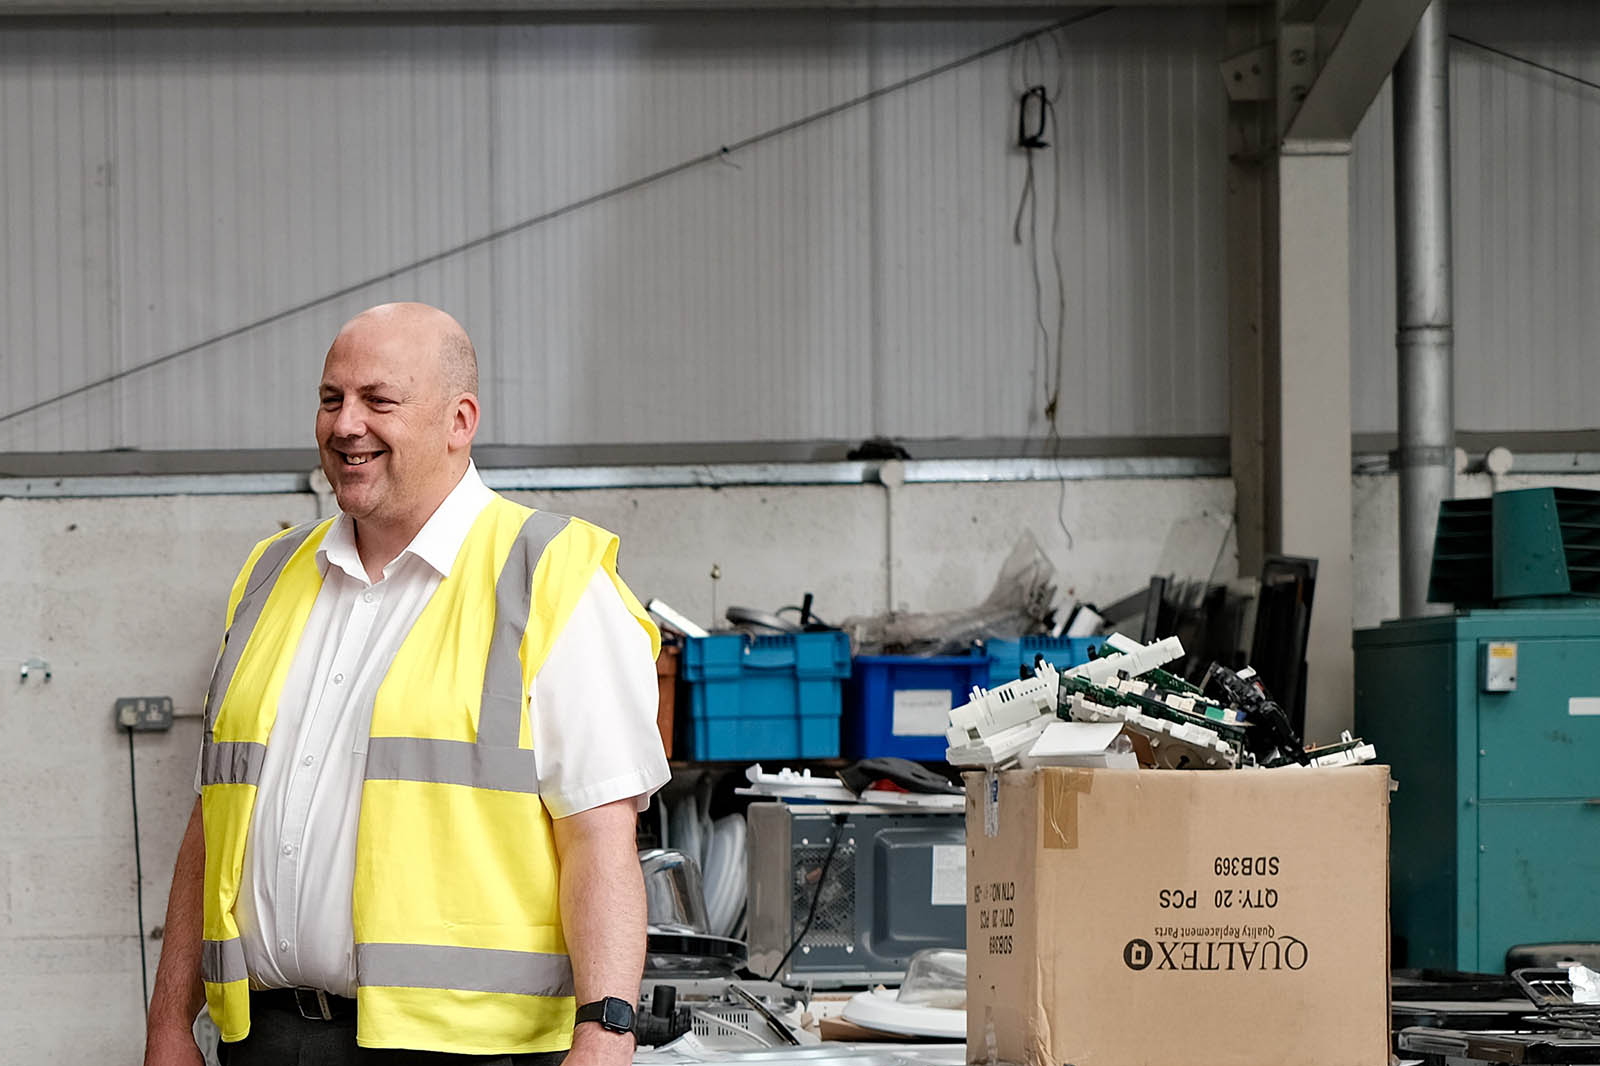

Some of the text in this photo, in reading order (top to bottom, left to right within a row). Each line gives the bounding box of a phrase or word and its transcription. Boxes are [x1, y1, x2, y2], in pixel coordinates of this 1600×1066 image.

[1214, 856, 1280, 876] SDB369
[1159, 888, 1278, 909] QTY: 20 PCS
[1154, 924, 1275, 939] Quality Replacement Parts
[1155, 935, 1309, 971] QUALTEX
